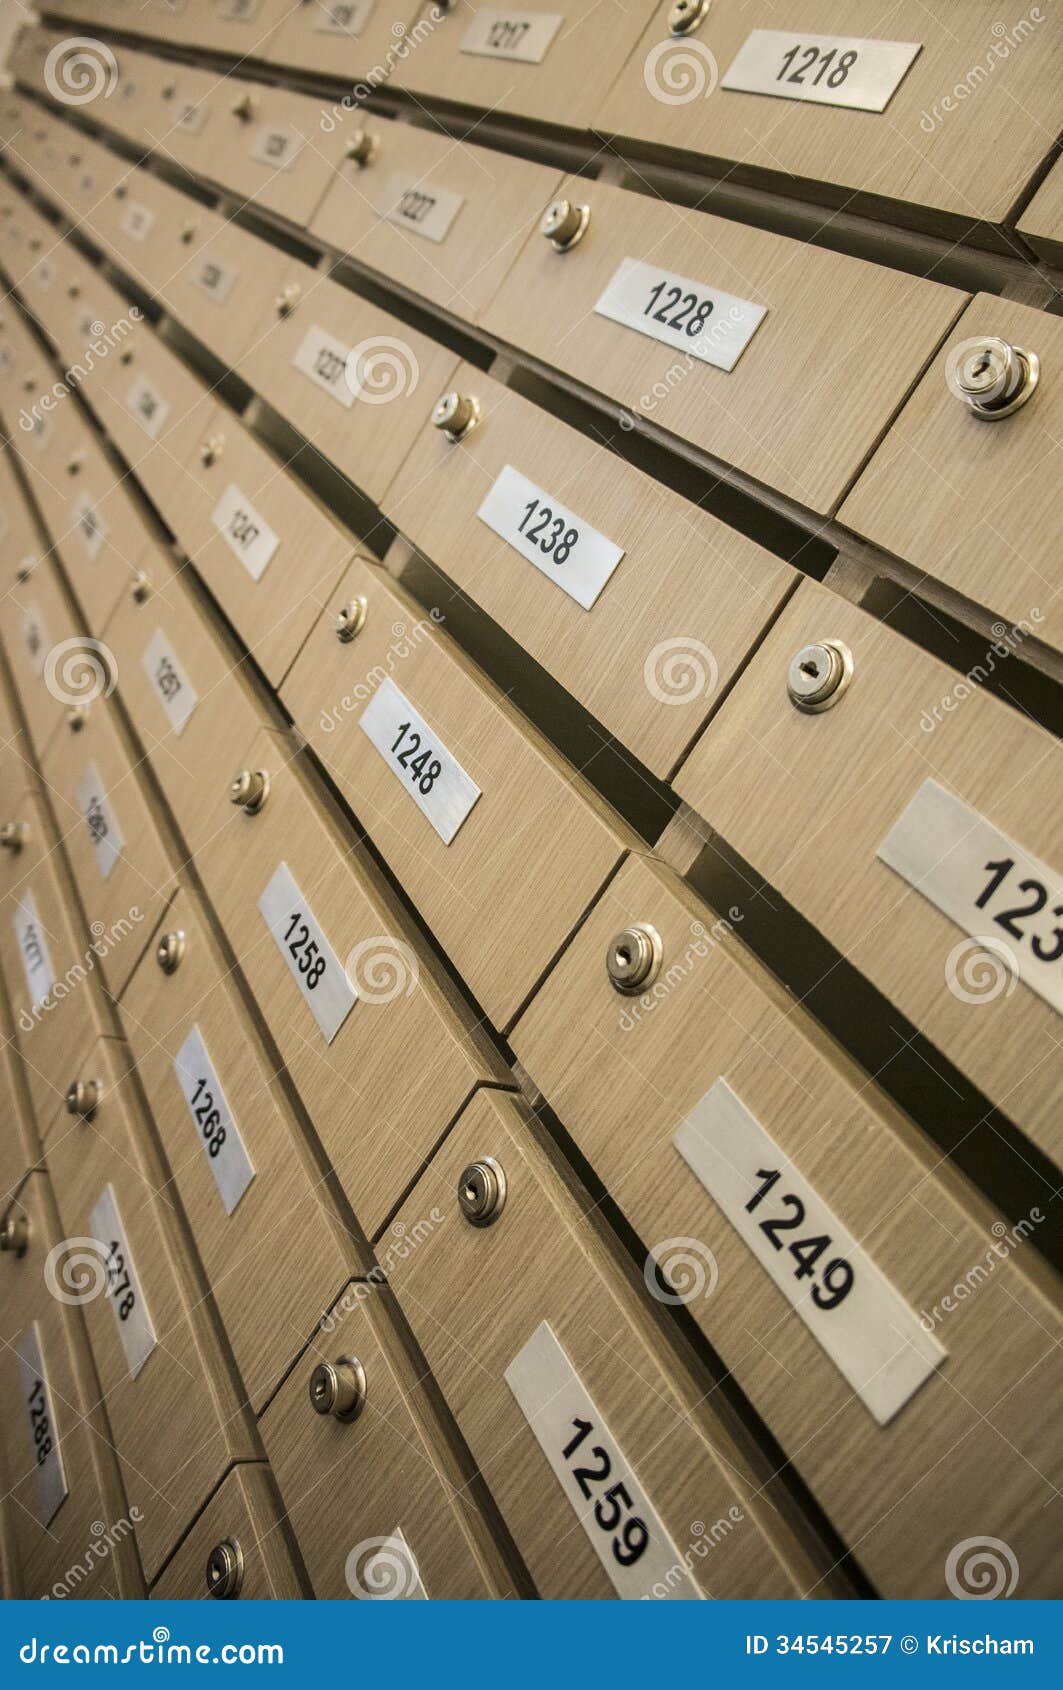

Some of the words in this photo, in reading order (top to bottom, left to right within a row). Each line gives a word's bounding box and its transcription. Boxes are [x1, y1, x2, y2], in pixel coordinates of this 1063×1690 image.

[486, 20, 532, 49] 1217
[775, 44, 858, 89] 1218
[643, 280, 715, 338] 1228
[517, 498, 579, 566] 1238
[390, 721, 442, 795] 1248
[974, 857, 1063, 963] 123
[283, 912, 327, 991] 1258
[190, 1078, 227, 1159] 1268
[744, 1167, 856, 1312] 1249
[104, 1239, 136, 1322] 1278
[27, 1379, 52, 1467] 1288
[561, 1417, 650, 1567] 1259
